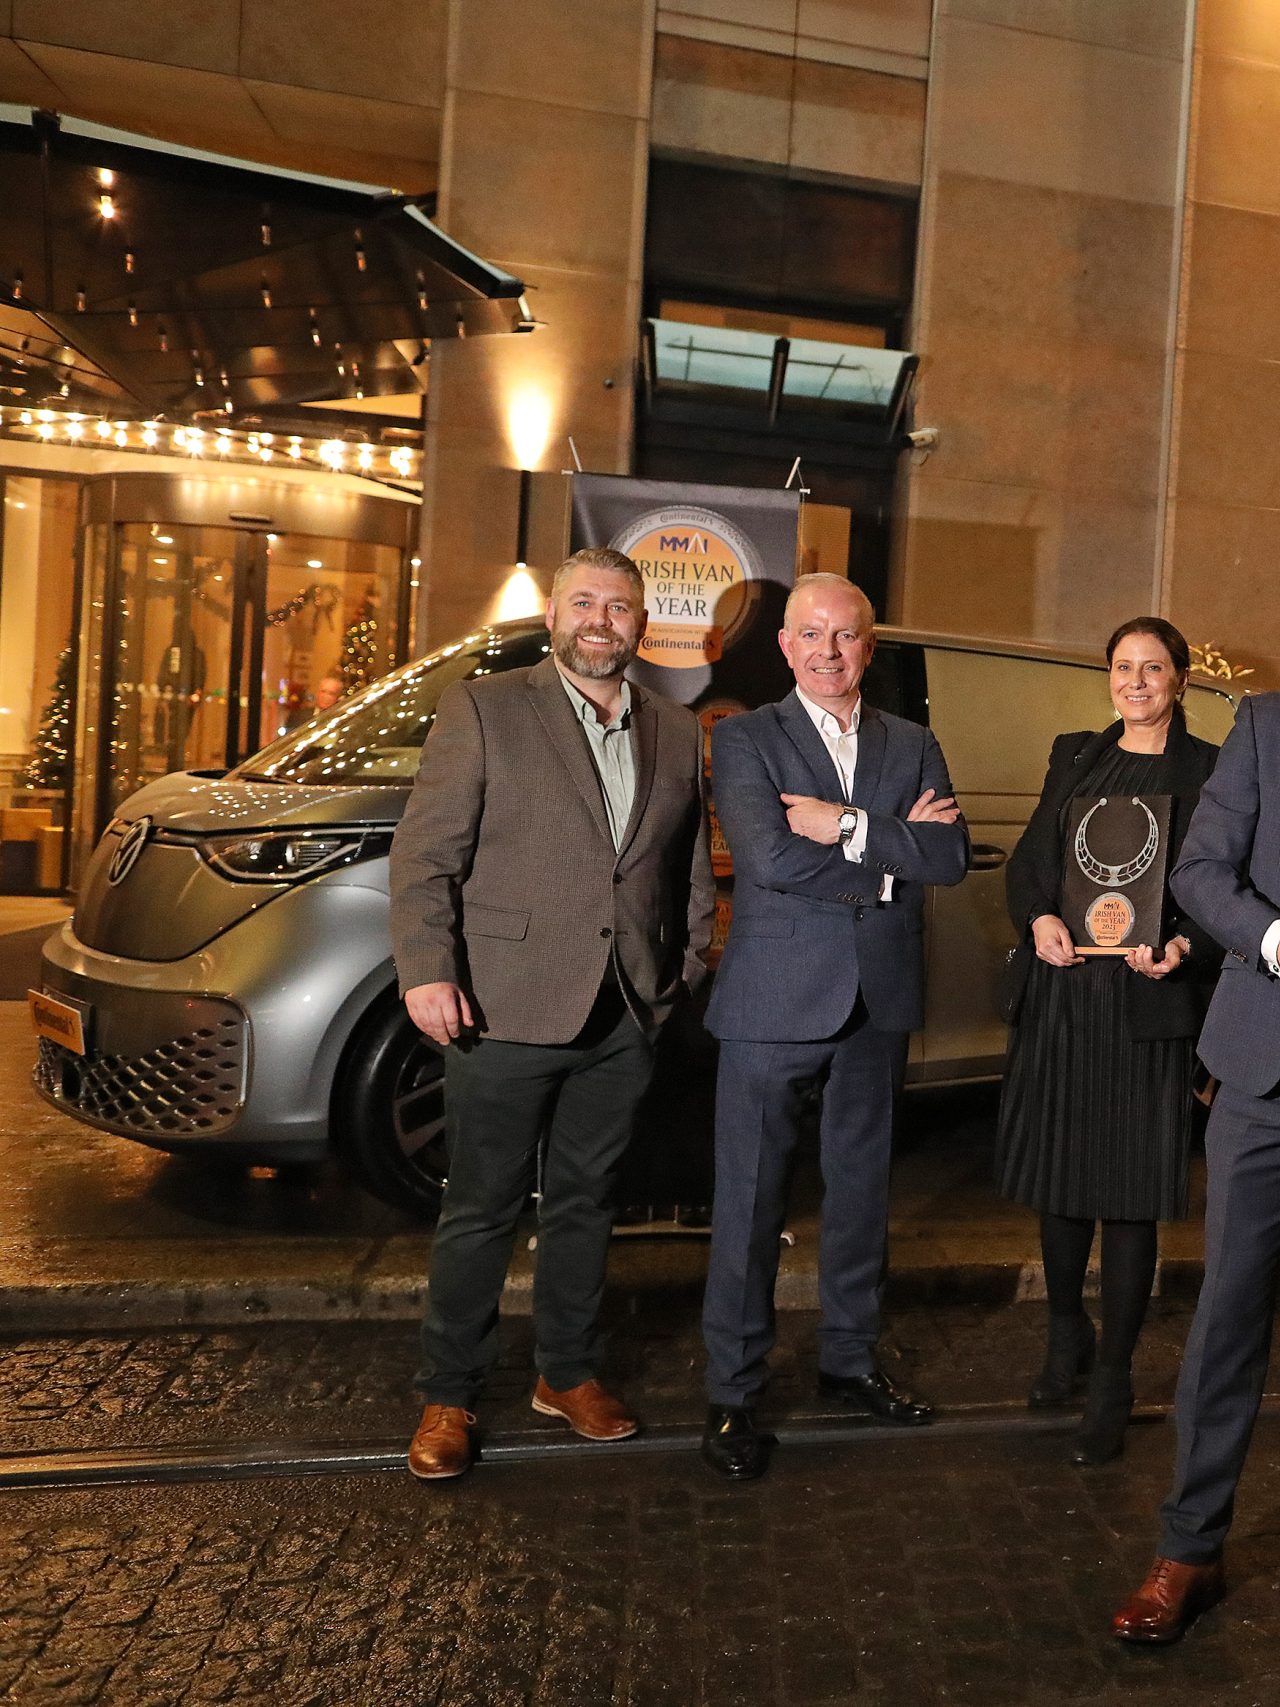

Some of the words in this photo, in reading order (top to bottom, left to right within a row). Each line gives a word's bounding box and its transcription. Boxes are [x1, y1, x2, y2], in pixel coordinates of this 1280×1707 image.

[633, 559, 685, 580] RISH
[693, 563, 734, 583] VAN
[657, 581, 674, 594] OF
[679, 582, 705, 596] THE
[655, 597, 707, 617] YEAR
[641, 636, 706, 650] Continental
